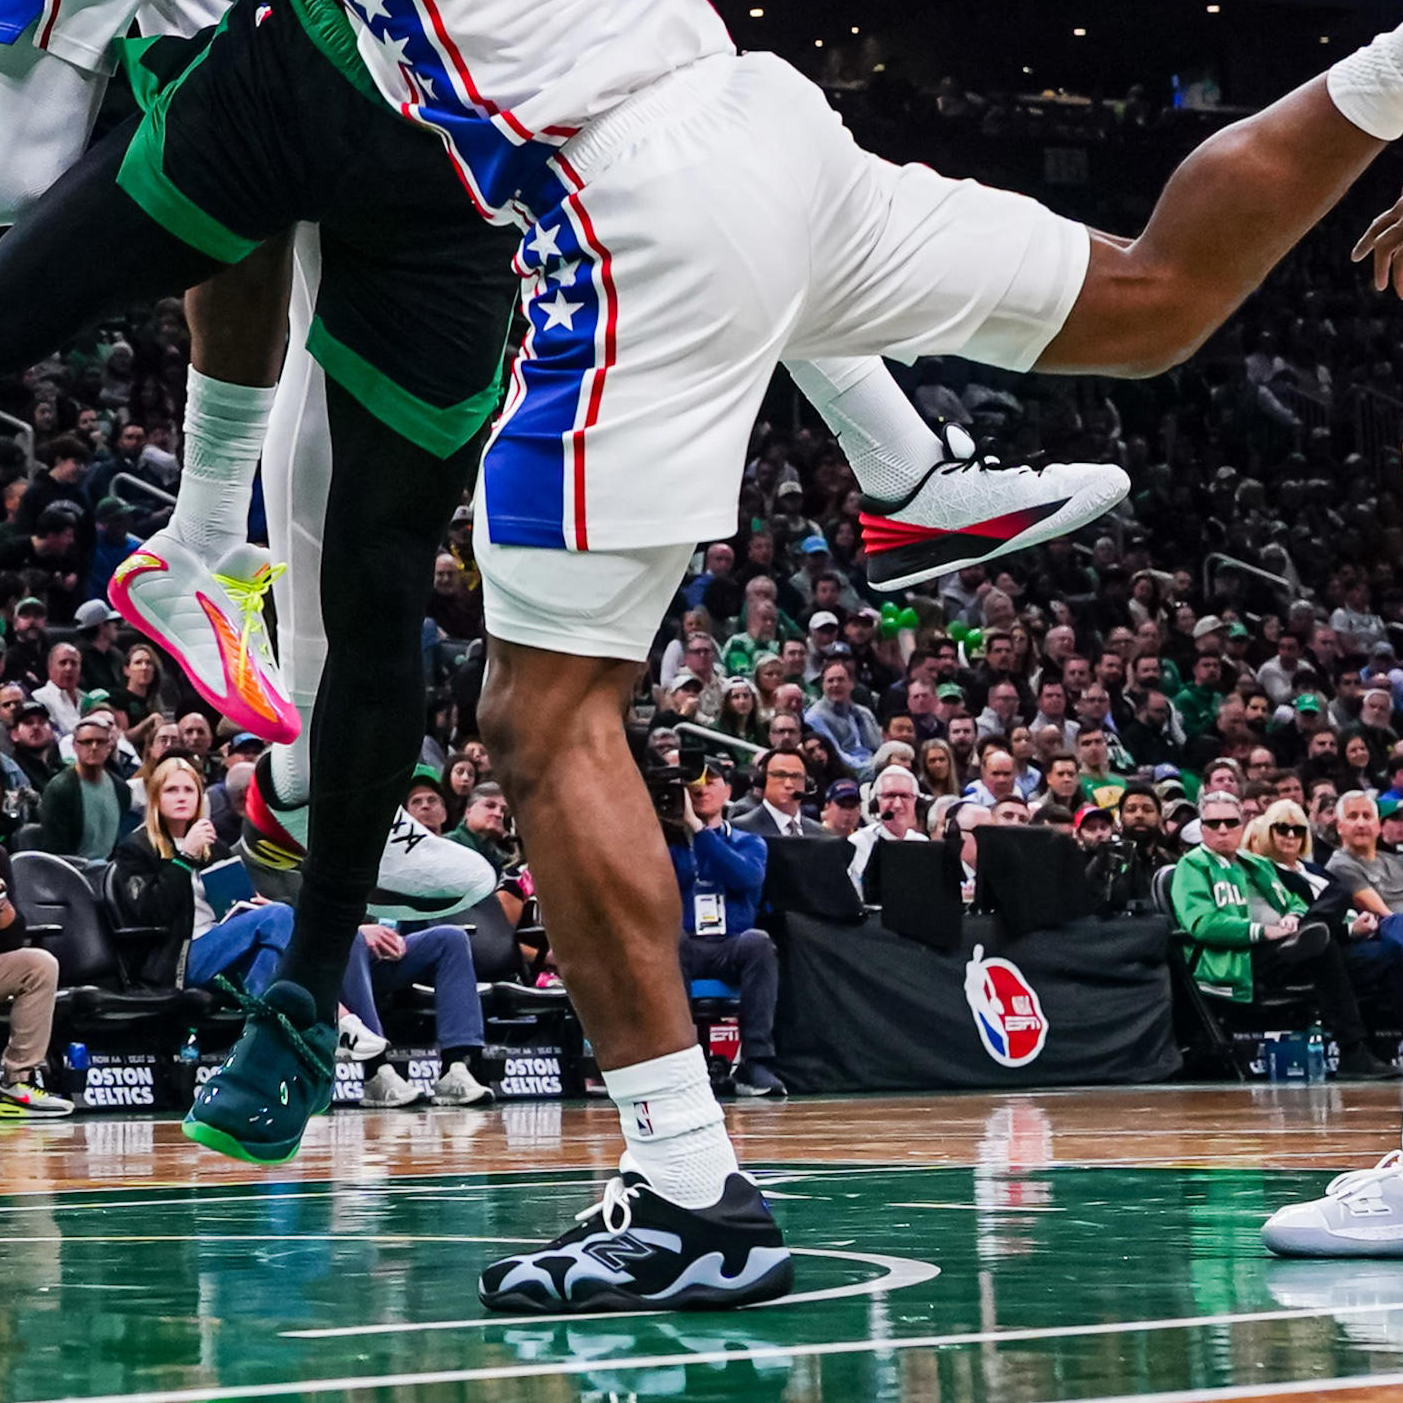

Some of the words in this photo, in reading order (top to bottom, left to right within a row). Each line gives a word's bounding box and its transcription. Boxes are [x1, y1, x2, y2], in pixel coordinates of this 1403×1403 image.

[86, 1066, 155, 1086] OSTON
[504, 1057, 562, 1076] OSTON
[500, 1075, 564, 1095] CELTICS
[83, 1086, 156, 1106] CELTICS
